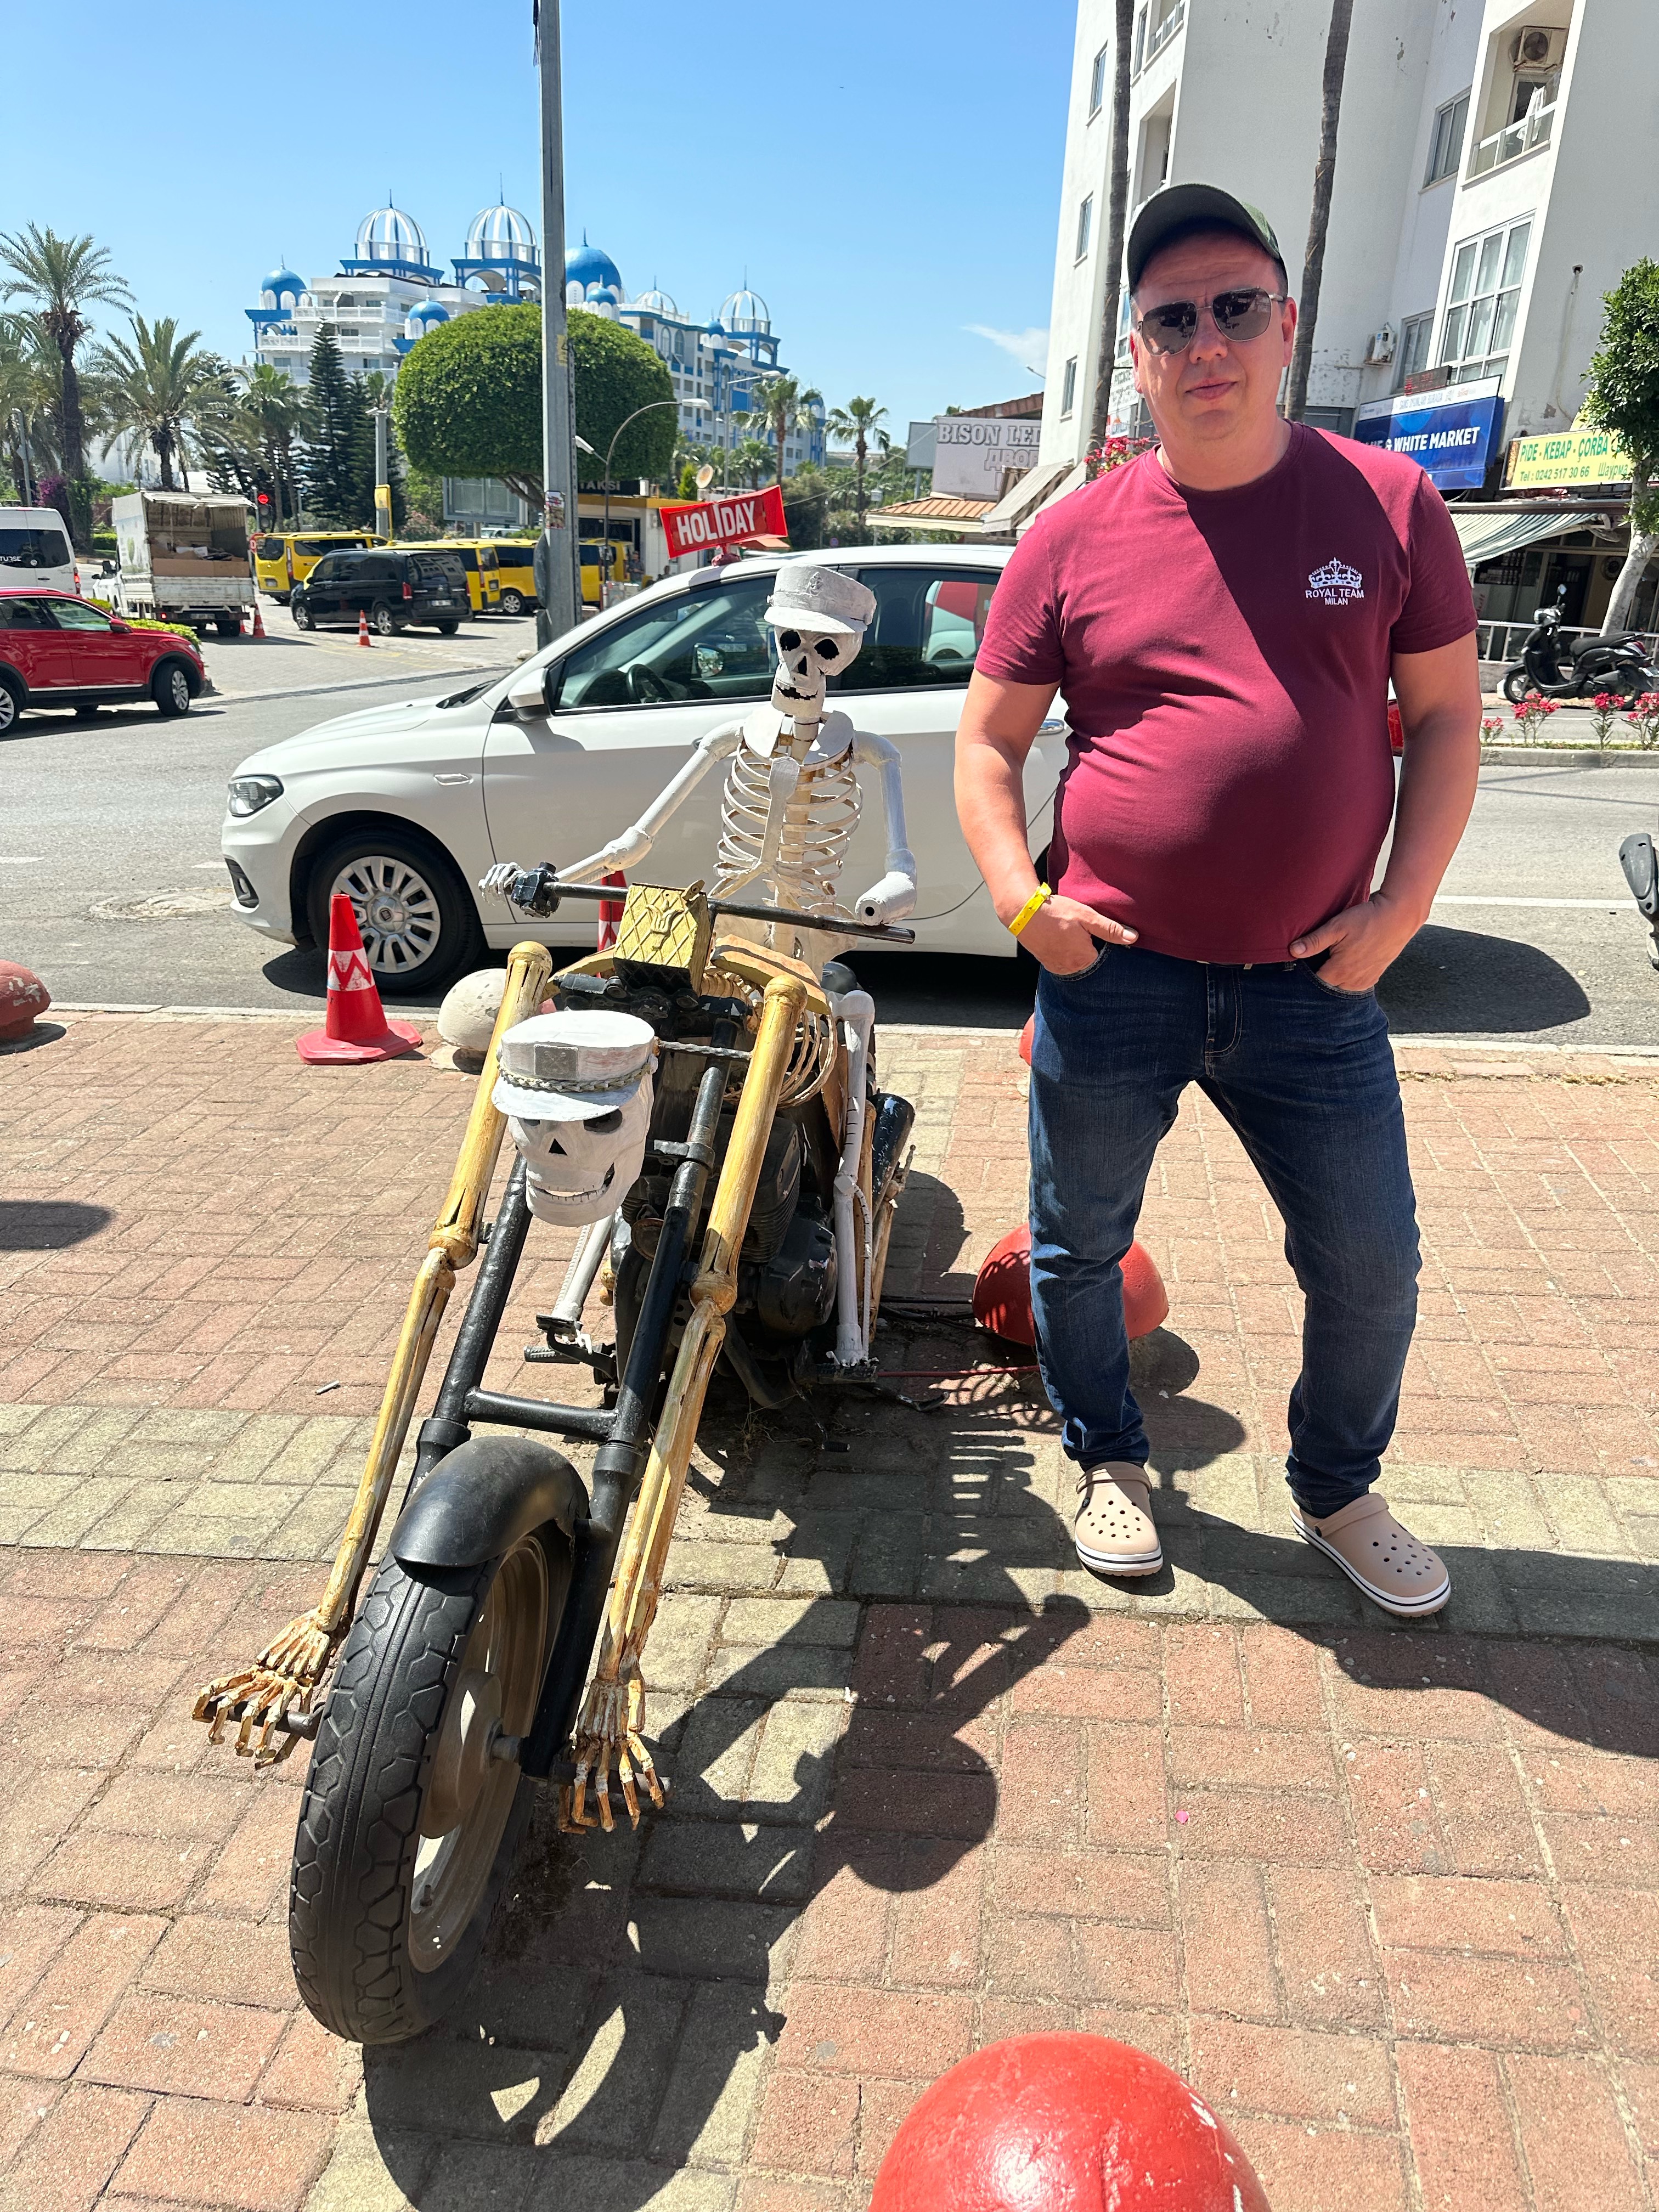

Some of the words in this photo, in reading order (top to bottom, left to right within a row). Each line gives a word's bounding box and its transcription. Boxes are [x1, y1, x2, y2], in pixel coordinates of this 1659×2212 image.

[937, 424, 1001, 446] BISON
[1393, 434, 1429, 452] WHITE
[1429, 426, 1481, 449] MARKET
[1543, 440, 1572, 460] KEBAP
[1577, 436, 1609, 462] ÇORBA
[1536, 469, 1553, 480] 0242
[1554, 467, 1568, 479] 517
[1568, 466, 1578, 478] 30
[1580, 466, 1590, 477] 66
[1598, 462, 1628, 481] Шаурма
[676, 501, 755, 546] HOLIDAY
[1305, 588, 1338, 599] ROYAL
[1339, 588, 1364, 599] TEAM
[1324, 597, 1348, 606] MILAN
